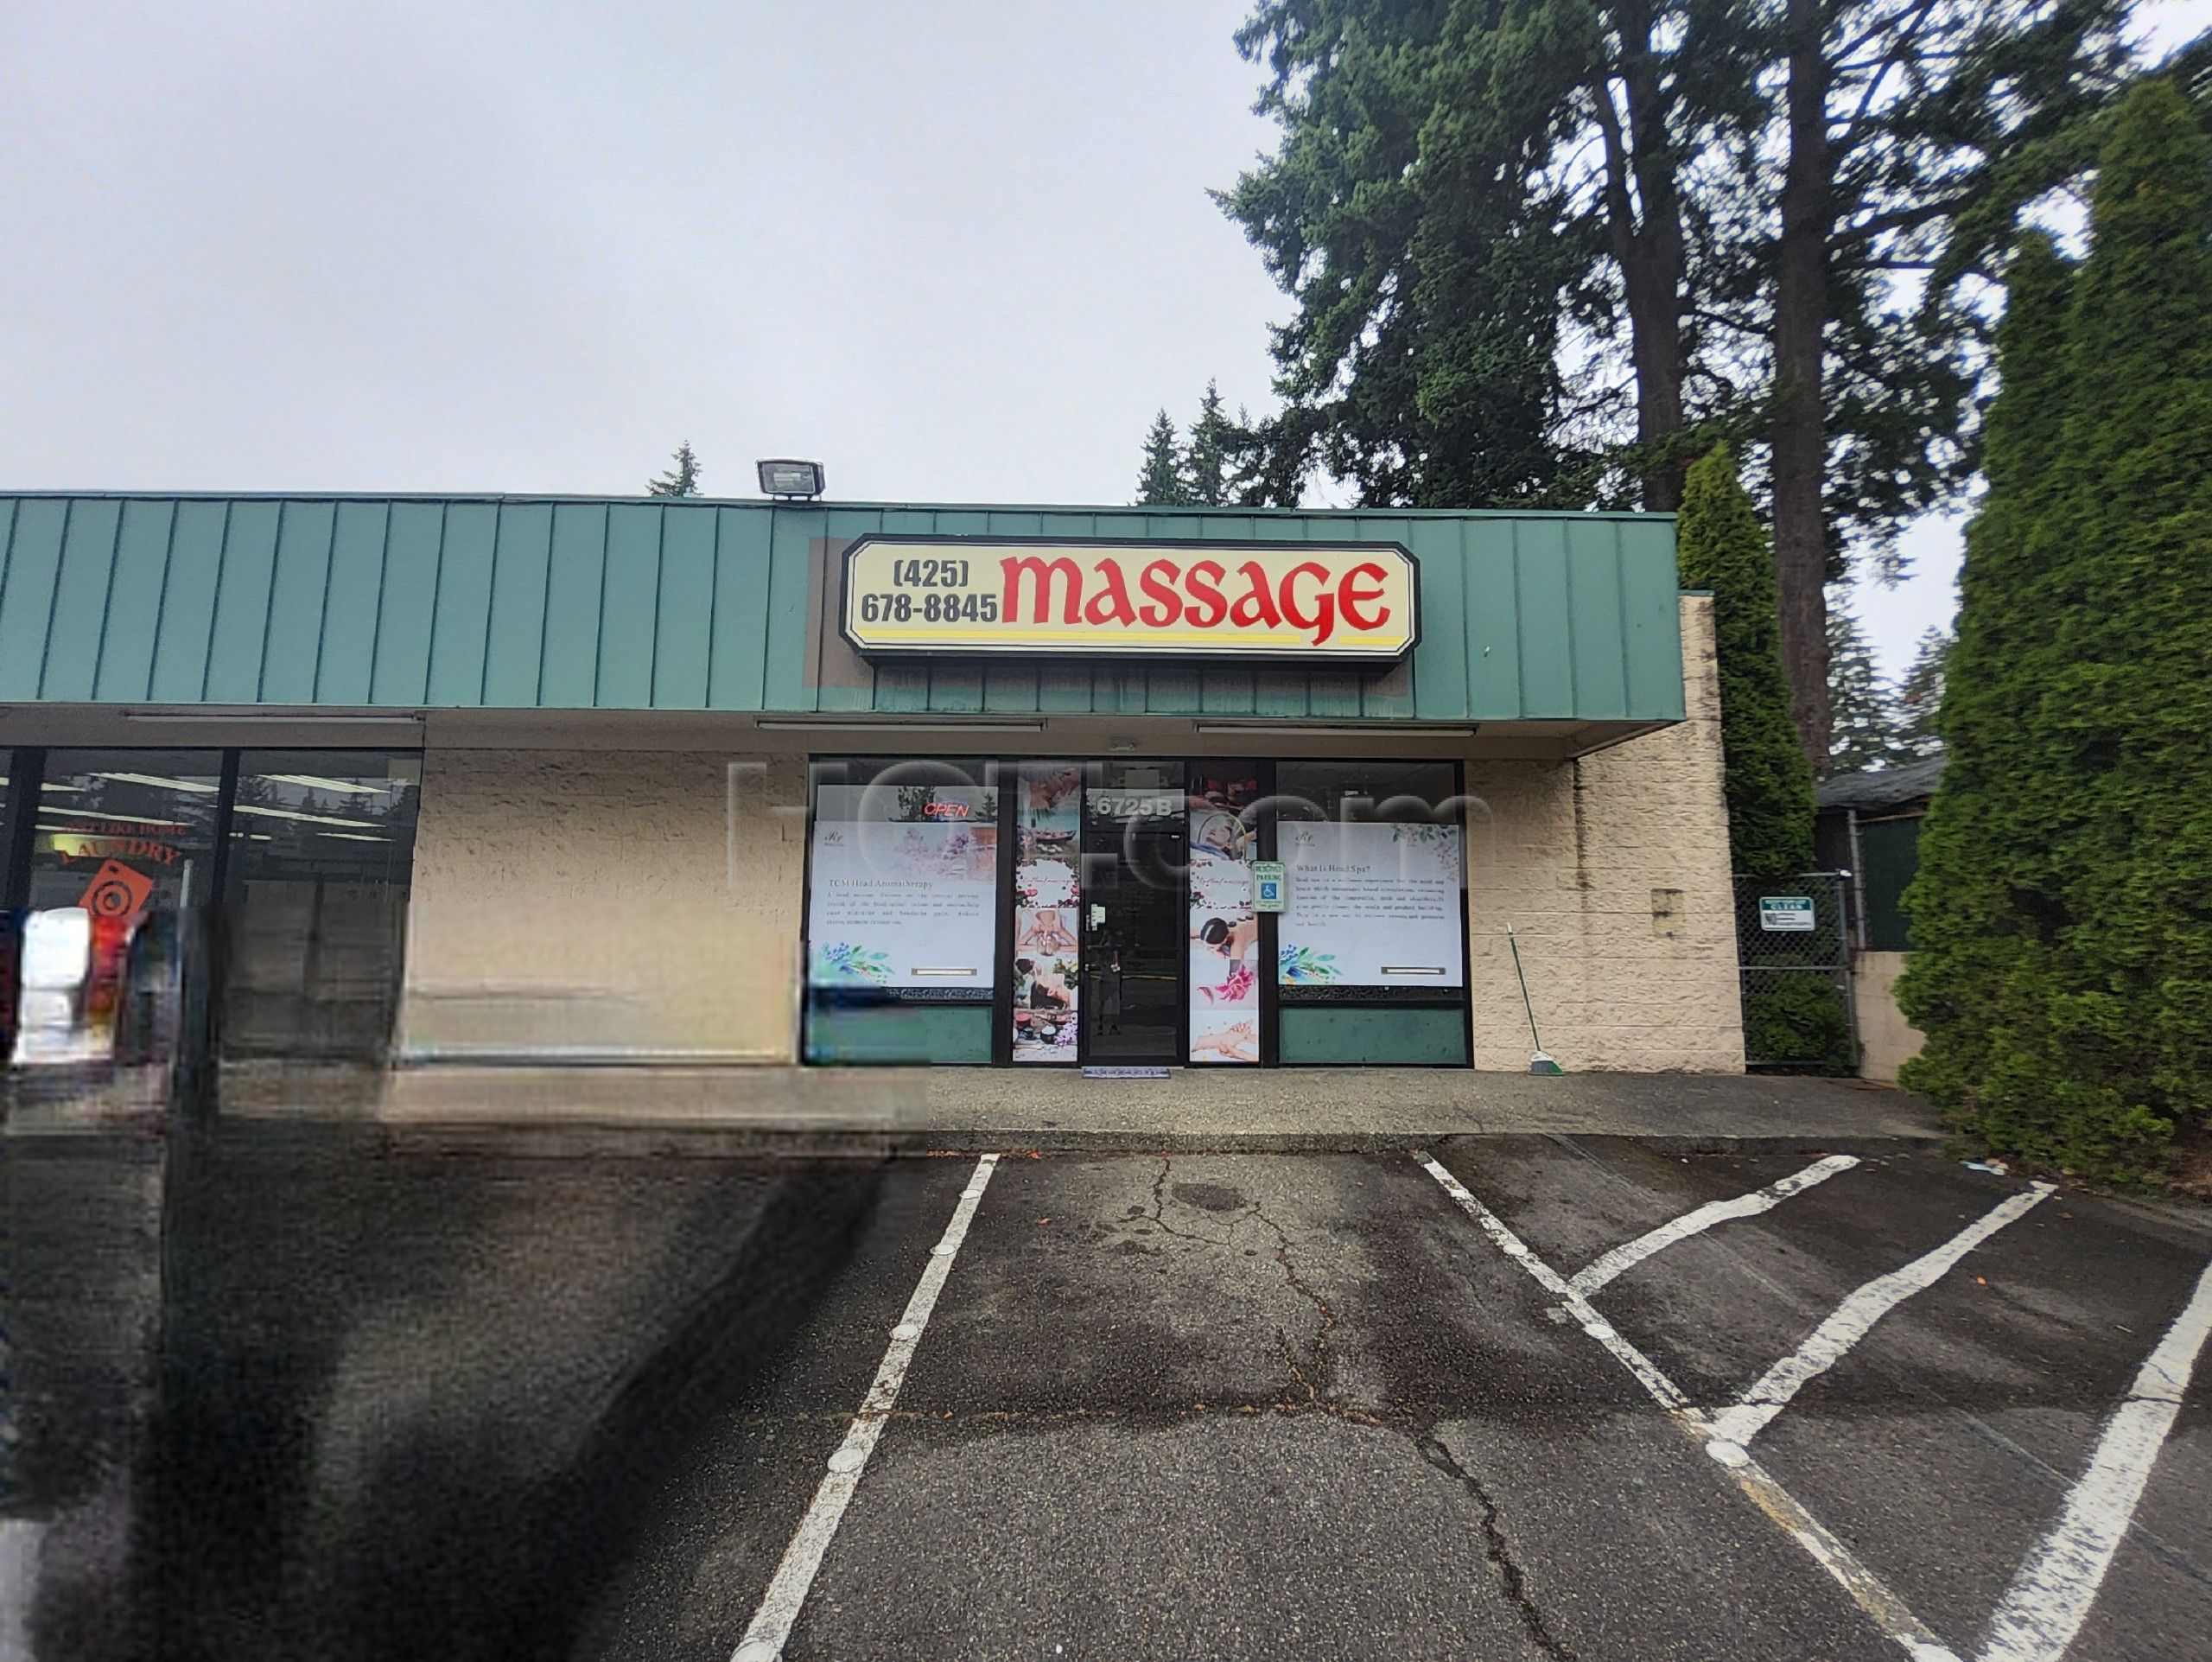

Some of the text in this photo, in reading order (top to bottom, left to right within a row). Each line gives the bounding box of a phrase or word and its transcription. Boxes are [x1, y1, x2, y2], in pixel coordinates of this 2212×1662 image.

[893, 559, 969, 588] (425)
[862, 593, 997, 623] 678-8845
[923, 801, 969, 818] OPEN
